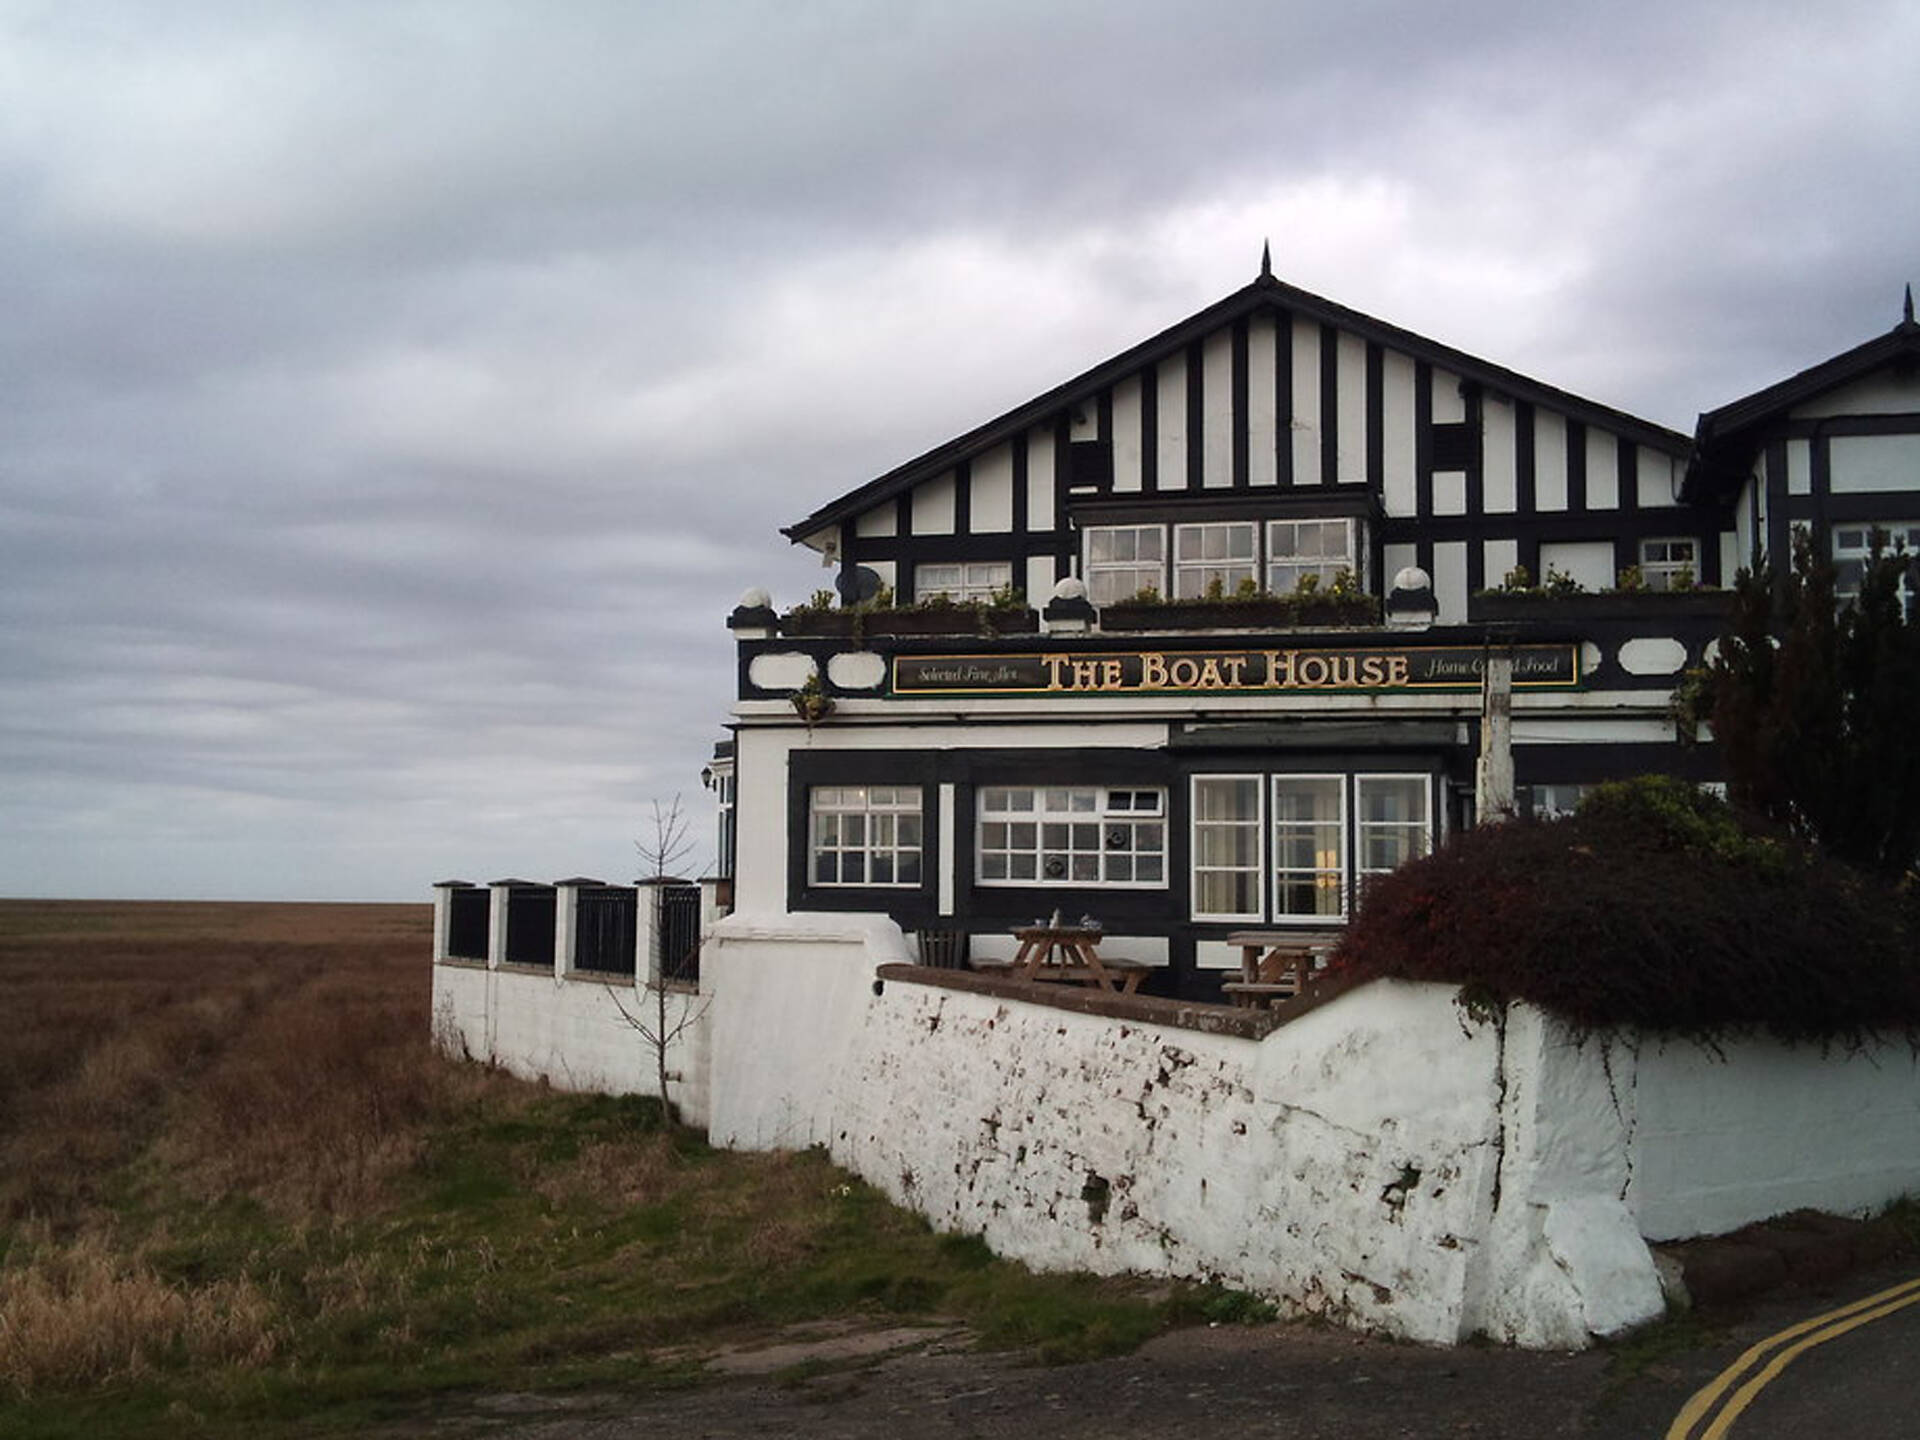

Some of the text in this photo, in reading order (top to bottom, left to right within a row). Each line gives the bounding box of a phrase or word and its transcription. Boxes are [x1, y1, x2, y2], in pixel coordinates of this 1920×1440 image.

[1041, 650, 1409, 691] THE BOAT HOUSE
[1424, 658, 1468, 678] Home
[1522, 656, 1559, 674] Food
